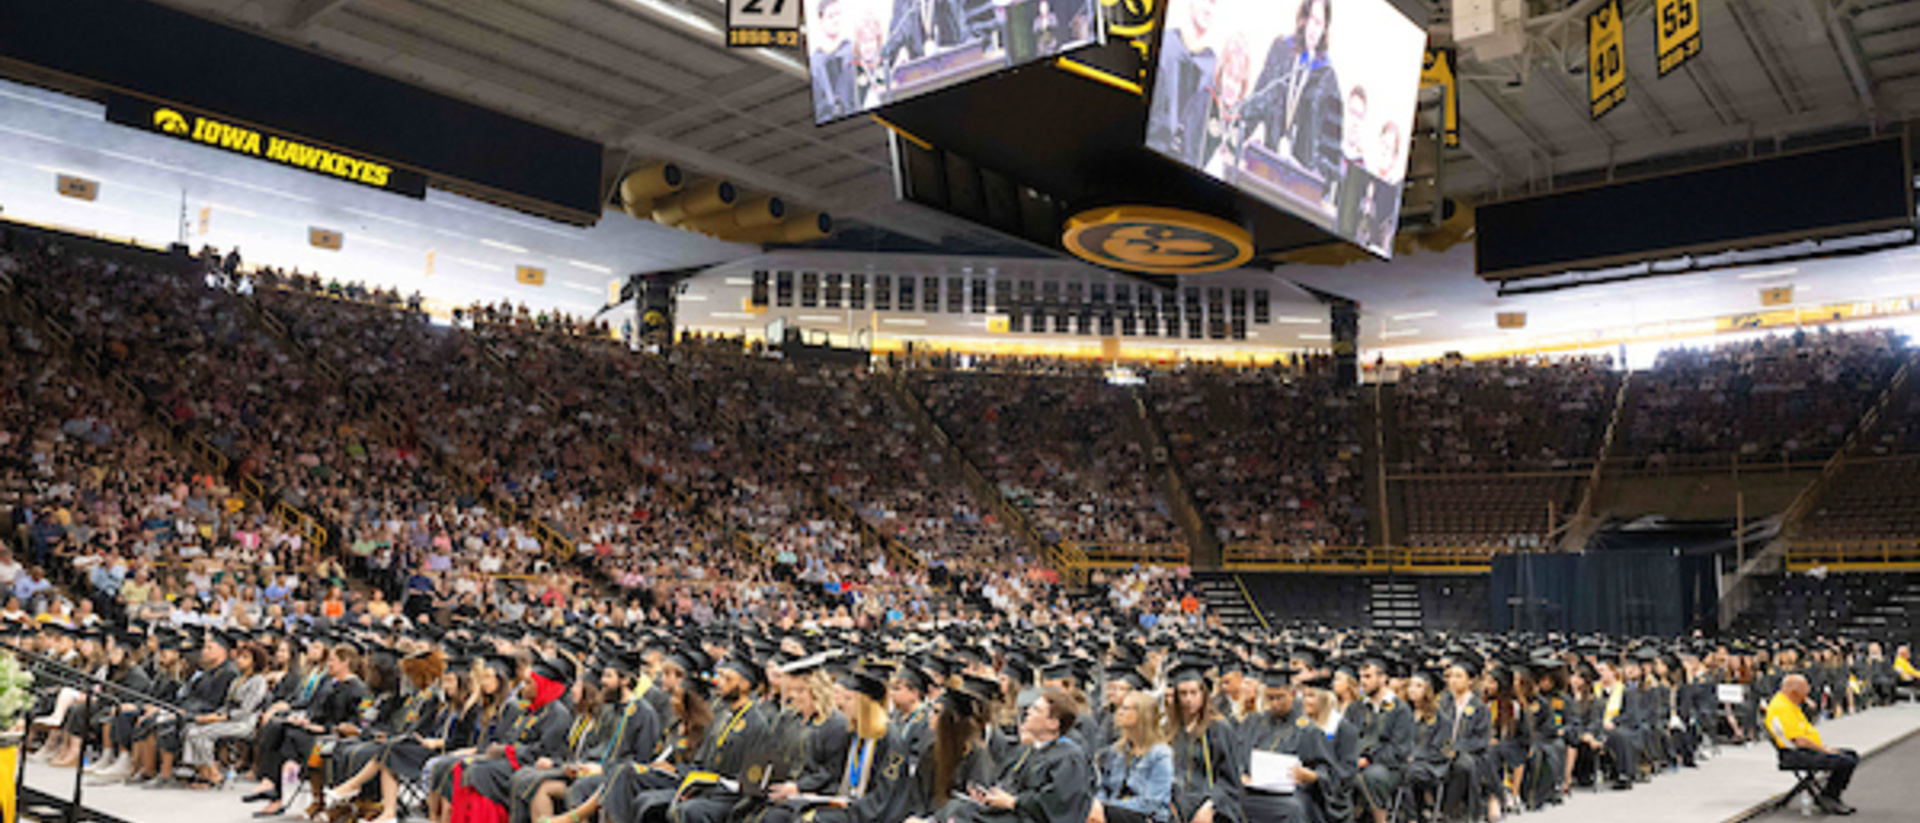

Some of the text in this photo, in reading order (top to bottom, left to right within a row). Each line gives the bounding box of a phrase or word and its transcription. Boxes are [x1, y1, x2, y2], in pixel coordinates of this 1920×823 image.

[1664, 2, 1692, 38] 55
[192, 117, 393, 186] IOWA HAWKEYES
